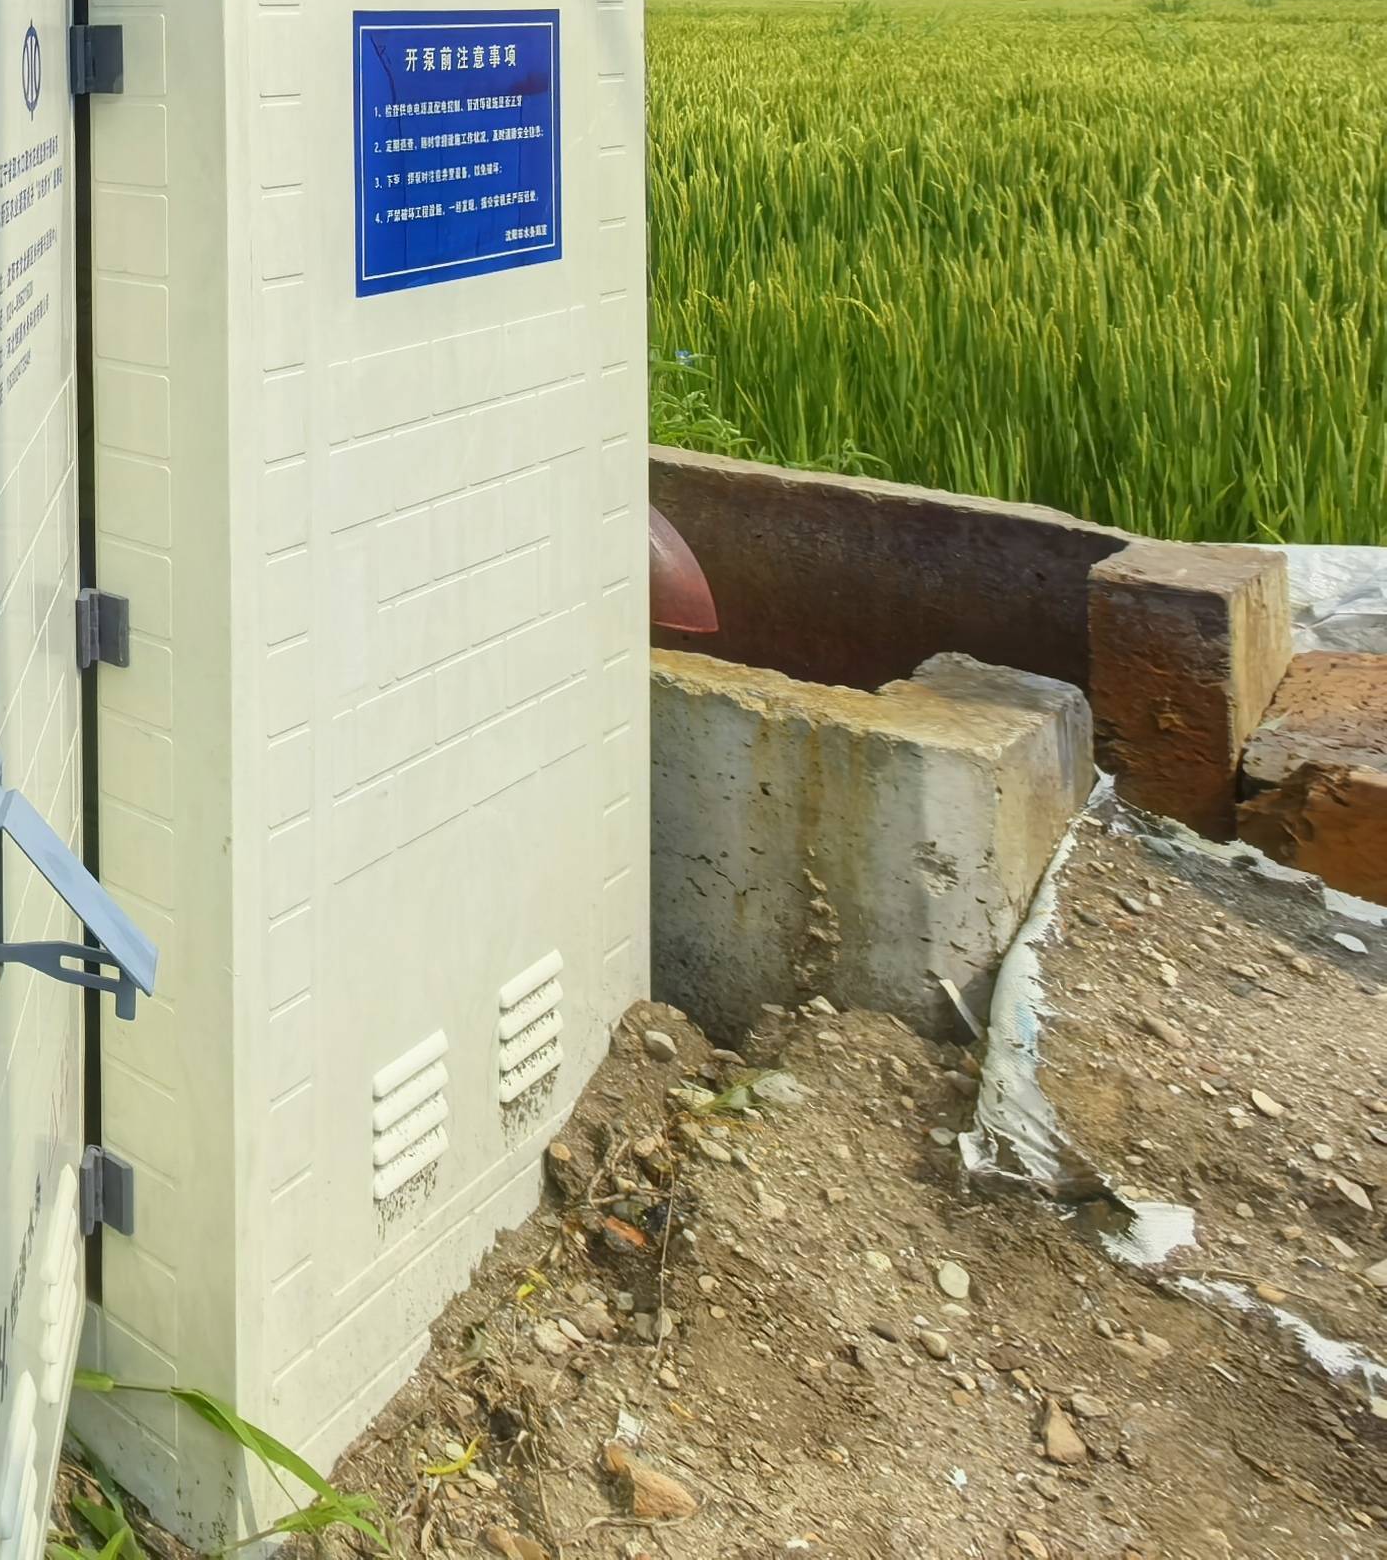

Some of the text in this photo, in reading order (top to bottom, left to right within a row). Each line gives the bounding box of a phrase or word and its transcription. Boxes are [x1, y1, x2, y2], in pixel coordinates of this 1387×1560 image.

[405, 44, 517, 72] 开泵前注意事项
